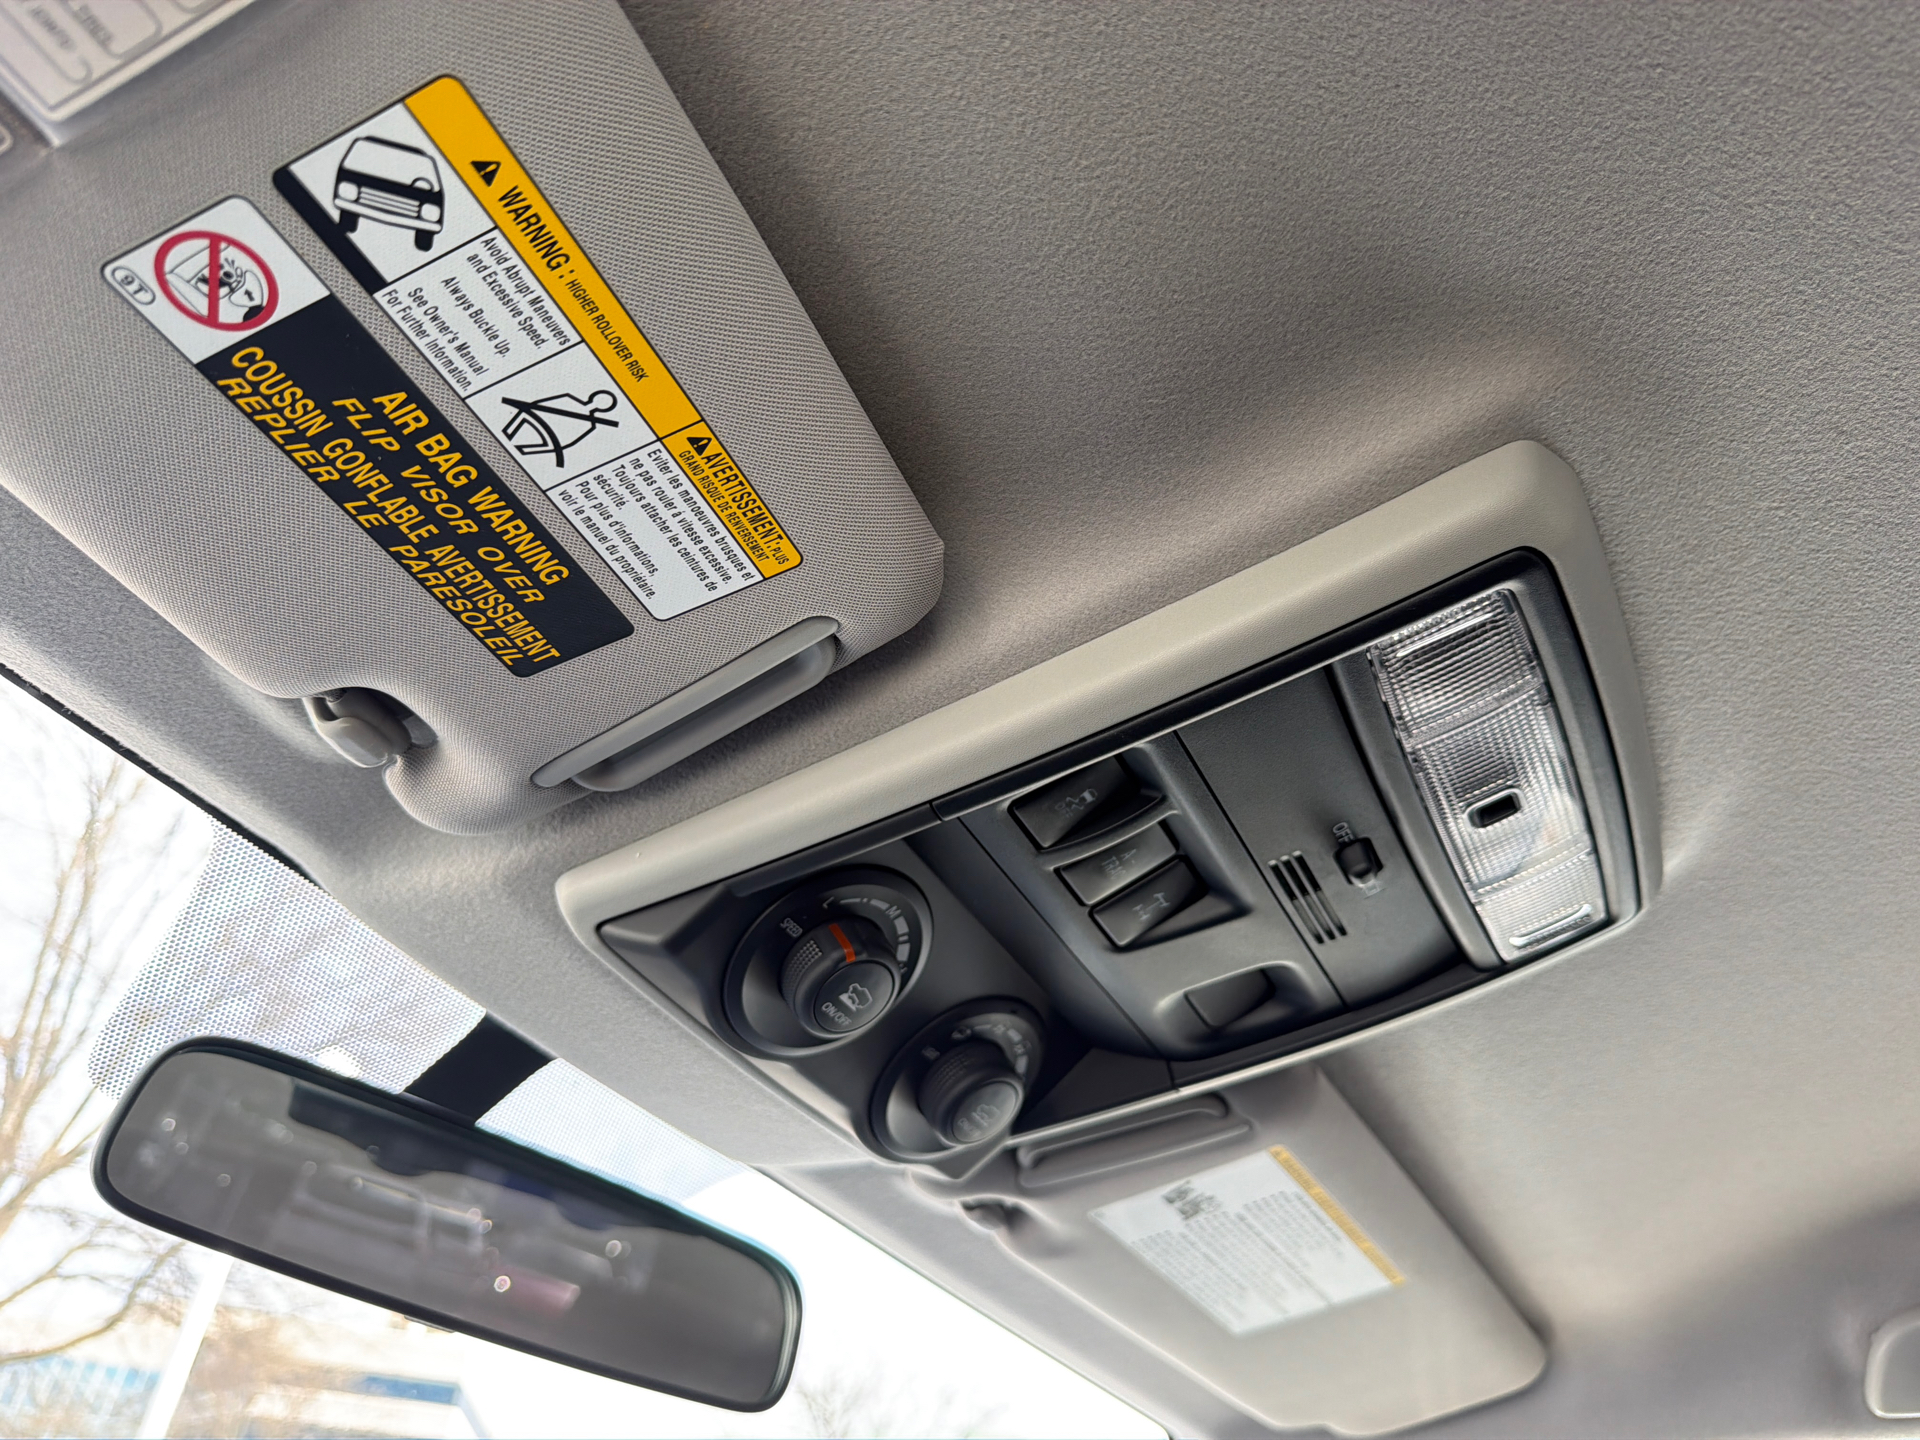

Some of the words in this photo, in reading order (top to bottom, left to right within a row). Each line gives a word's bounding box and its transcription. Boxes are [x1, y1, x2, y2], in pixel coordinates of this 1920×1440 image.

[119, 273, 150, 296] 9T
[465, 252, 492, 274] and
[480, 269, 524, 319] Excessive
[516, 315, 550, 350] Speed.
[479, 235, 512, 266] Avoid
[500, 263, 536, 298] Abrupt
[525, 294, 571, 346] Maneuvers
[497, 184, 571, 272] WARNING
[564, 277, 600, 316] HIGHER
[590, 312, 633, 361] ROLLOVER
[624, 358, 649, 383] RISK
[406, 286, 429, 308] See
[422, 304, 460, 344] Owner's
[452, 340, 490, 376] Manual
[439, 275, 475, 312] Always
[467, 307, 500, 342] Buckle
[492, 338, 511, 358] Up.
[381, 287, 403, 308] For
[395, 304, 431, 340] Further
[423, 337, 472, 392] Information.
[627, 456, 645, 470] ne
[633, 464, 658, 487] pas
[677, 449, 705, 477] GRAND
[230, 345, 334, 438] COUSSIN
[321, 437, 440, 544] GONFLABLE
[423, 543, 561, 663] AVERTISSEMENT
[331, 397, 401, 452] FLIP
[400, 464, 480, 535] VISOR
[476, 545, 546, 603] OVER
[371, 390, 430, 436] AIR
[414, 432, 479, 489] BAG
[466, 484, 570, 586] WARNING
[557, 488, 579, 507] voir
[591, 473, 626, 511] sécurité.
[650, 485, 678, 511] rouler
[696, 474, 725, 503] RISQUE
[716, 500, 733, 513] DE
[216, 376, 341, 483] REPLIER
[342, 499, 390, 529] LE
[387, 544, 524, 666] PARESOLEIL
[570, 503, 586, 516] le
[610, 462, 647, 503] Toujours
[639, 501, 673, 535] attacher
[665, 531, 683, 548] les
[675, 546, 710, 582] ceintures
[703, 580, 718, 592] de
[645, 447, 674, 476] Eviter
[665, 472, 684, 490] les
[676, 488, 721, 538] manoeuvres
[713, 534, 747, 573] brusques
[740, 570, 756, 582] et
[699, 451, 784, 549] AVERTISSEMENT:
[769, 545, 790, 565] PLUS
[574, 479, 599, 502] Pour
[587, 500, 614, 521] plus
[607, 519, 659, 577] d'informations,
[579, 514, 614, 545] manuel
[675, 516, 704, 546] vitesse
[724, 510, 770, 562] RENVERSEMENT
[604, 543, 620, 556] du
[697, 544, 733, 585] excessive.
[610, 554, 656, 600] propriétaire.
[1332, 821, 1355, 844] OFF
[779, 917, 803, 938] SPEED
[885, 905, 901, 919] M
[821, 1002, 852, 1026] ON/OFF
